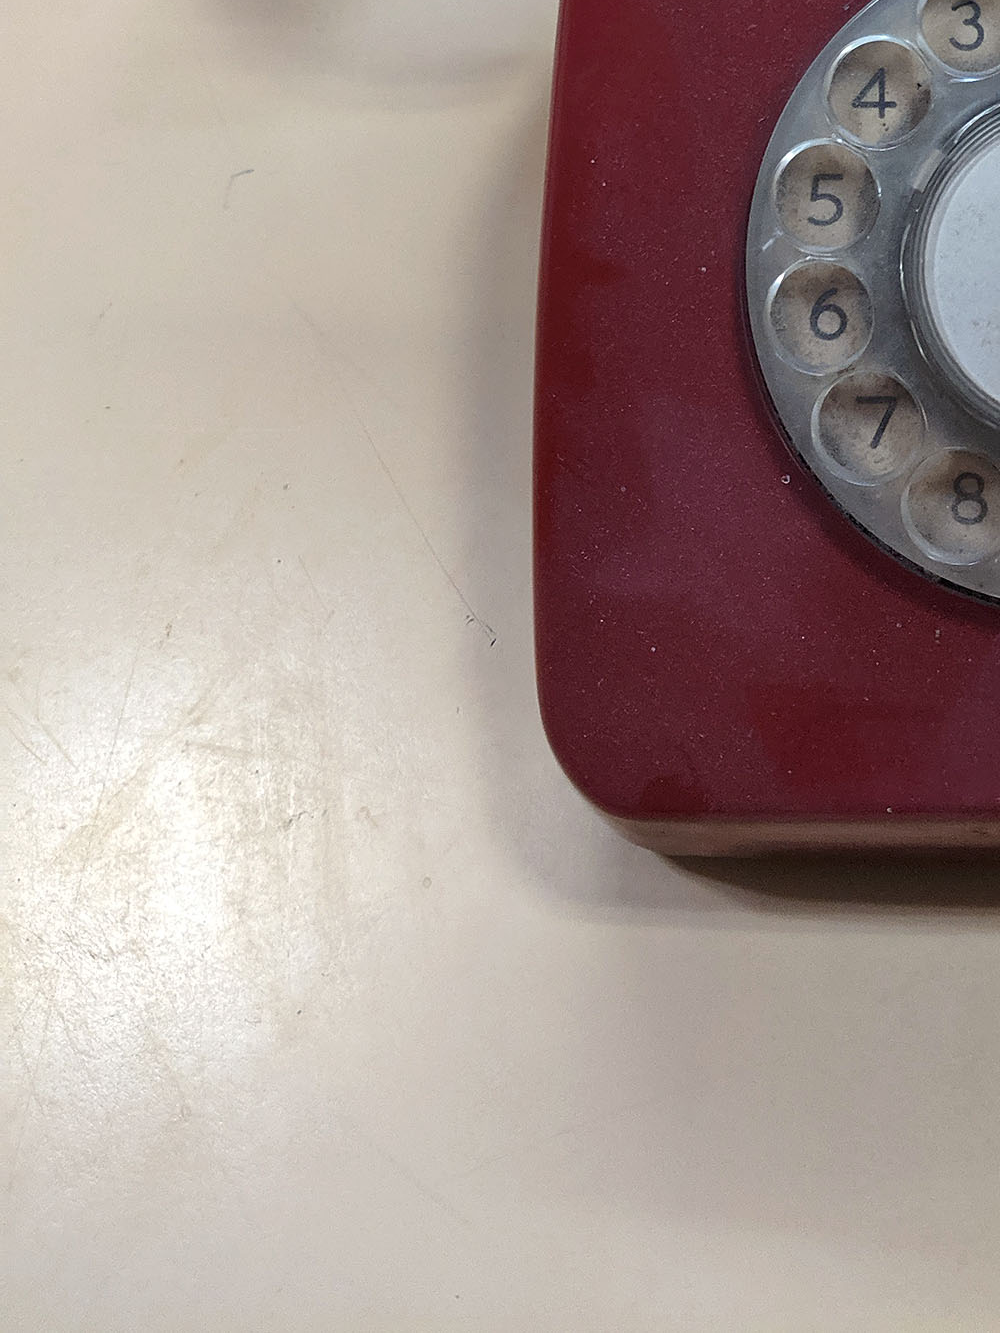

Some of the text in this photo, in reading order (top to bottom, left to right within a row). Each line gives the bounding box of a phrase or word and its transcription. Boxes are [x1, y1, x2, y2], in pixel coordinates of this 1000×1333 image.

[949, 0, 985, 52] 3
[851, 67, 897, 119] 4
[806, 174, 844, 227] 5
[809, 288, 848, 341] 6
[855, 395, 896, 449] 7
[950, 472, 989, 525] 8
